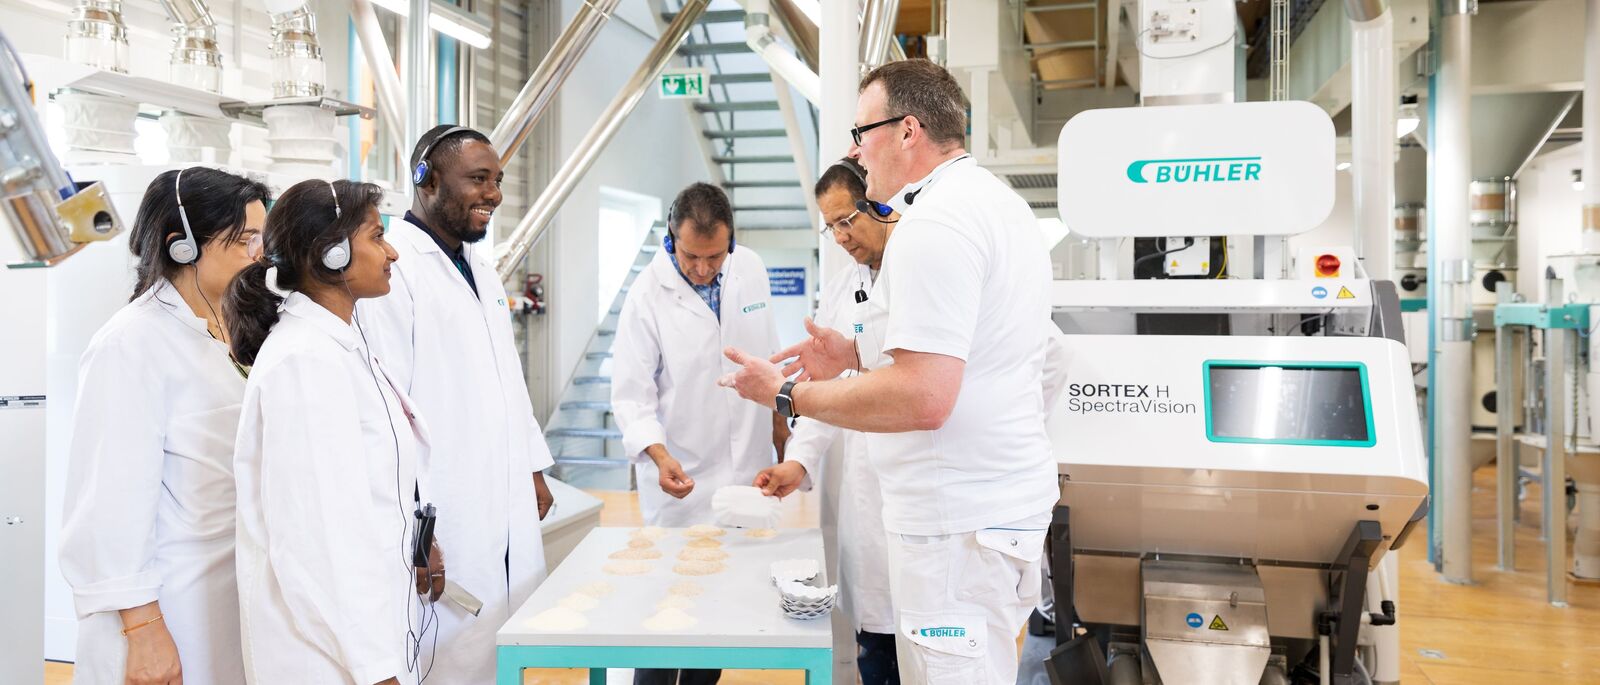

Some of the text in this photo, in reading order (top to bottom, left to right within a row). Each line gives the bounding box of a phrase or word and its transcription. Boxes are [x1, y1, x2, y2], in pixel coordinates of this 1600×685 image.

[1156, 163, 1262, 183] BÜHLER
[1069, 384, 1169, 398] SORTEX H
[1069, 398, 1196, 415] SpectraVision
